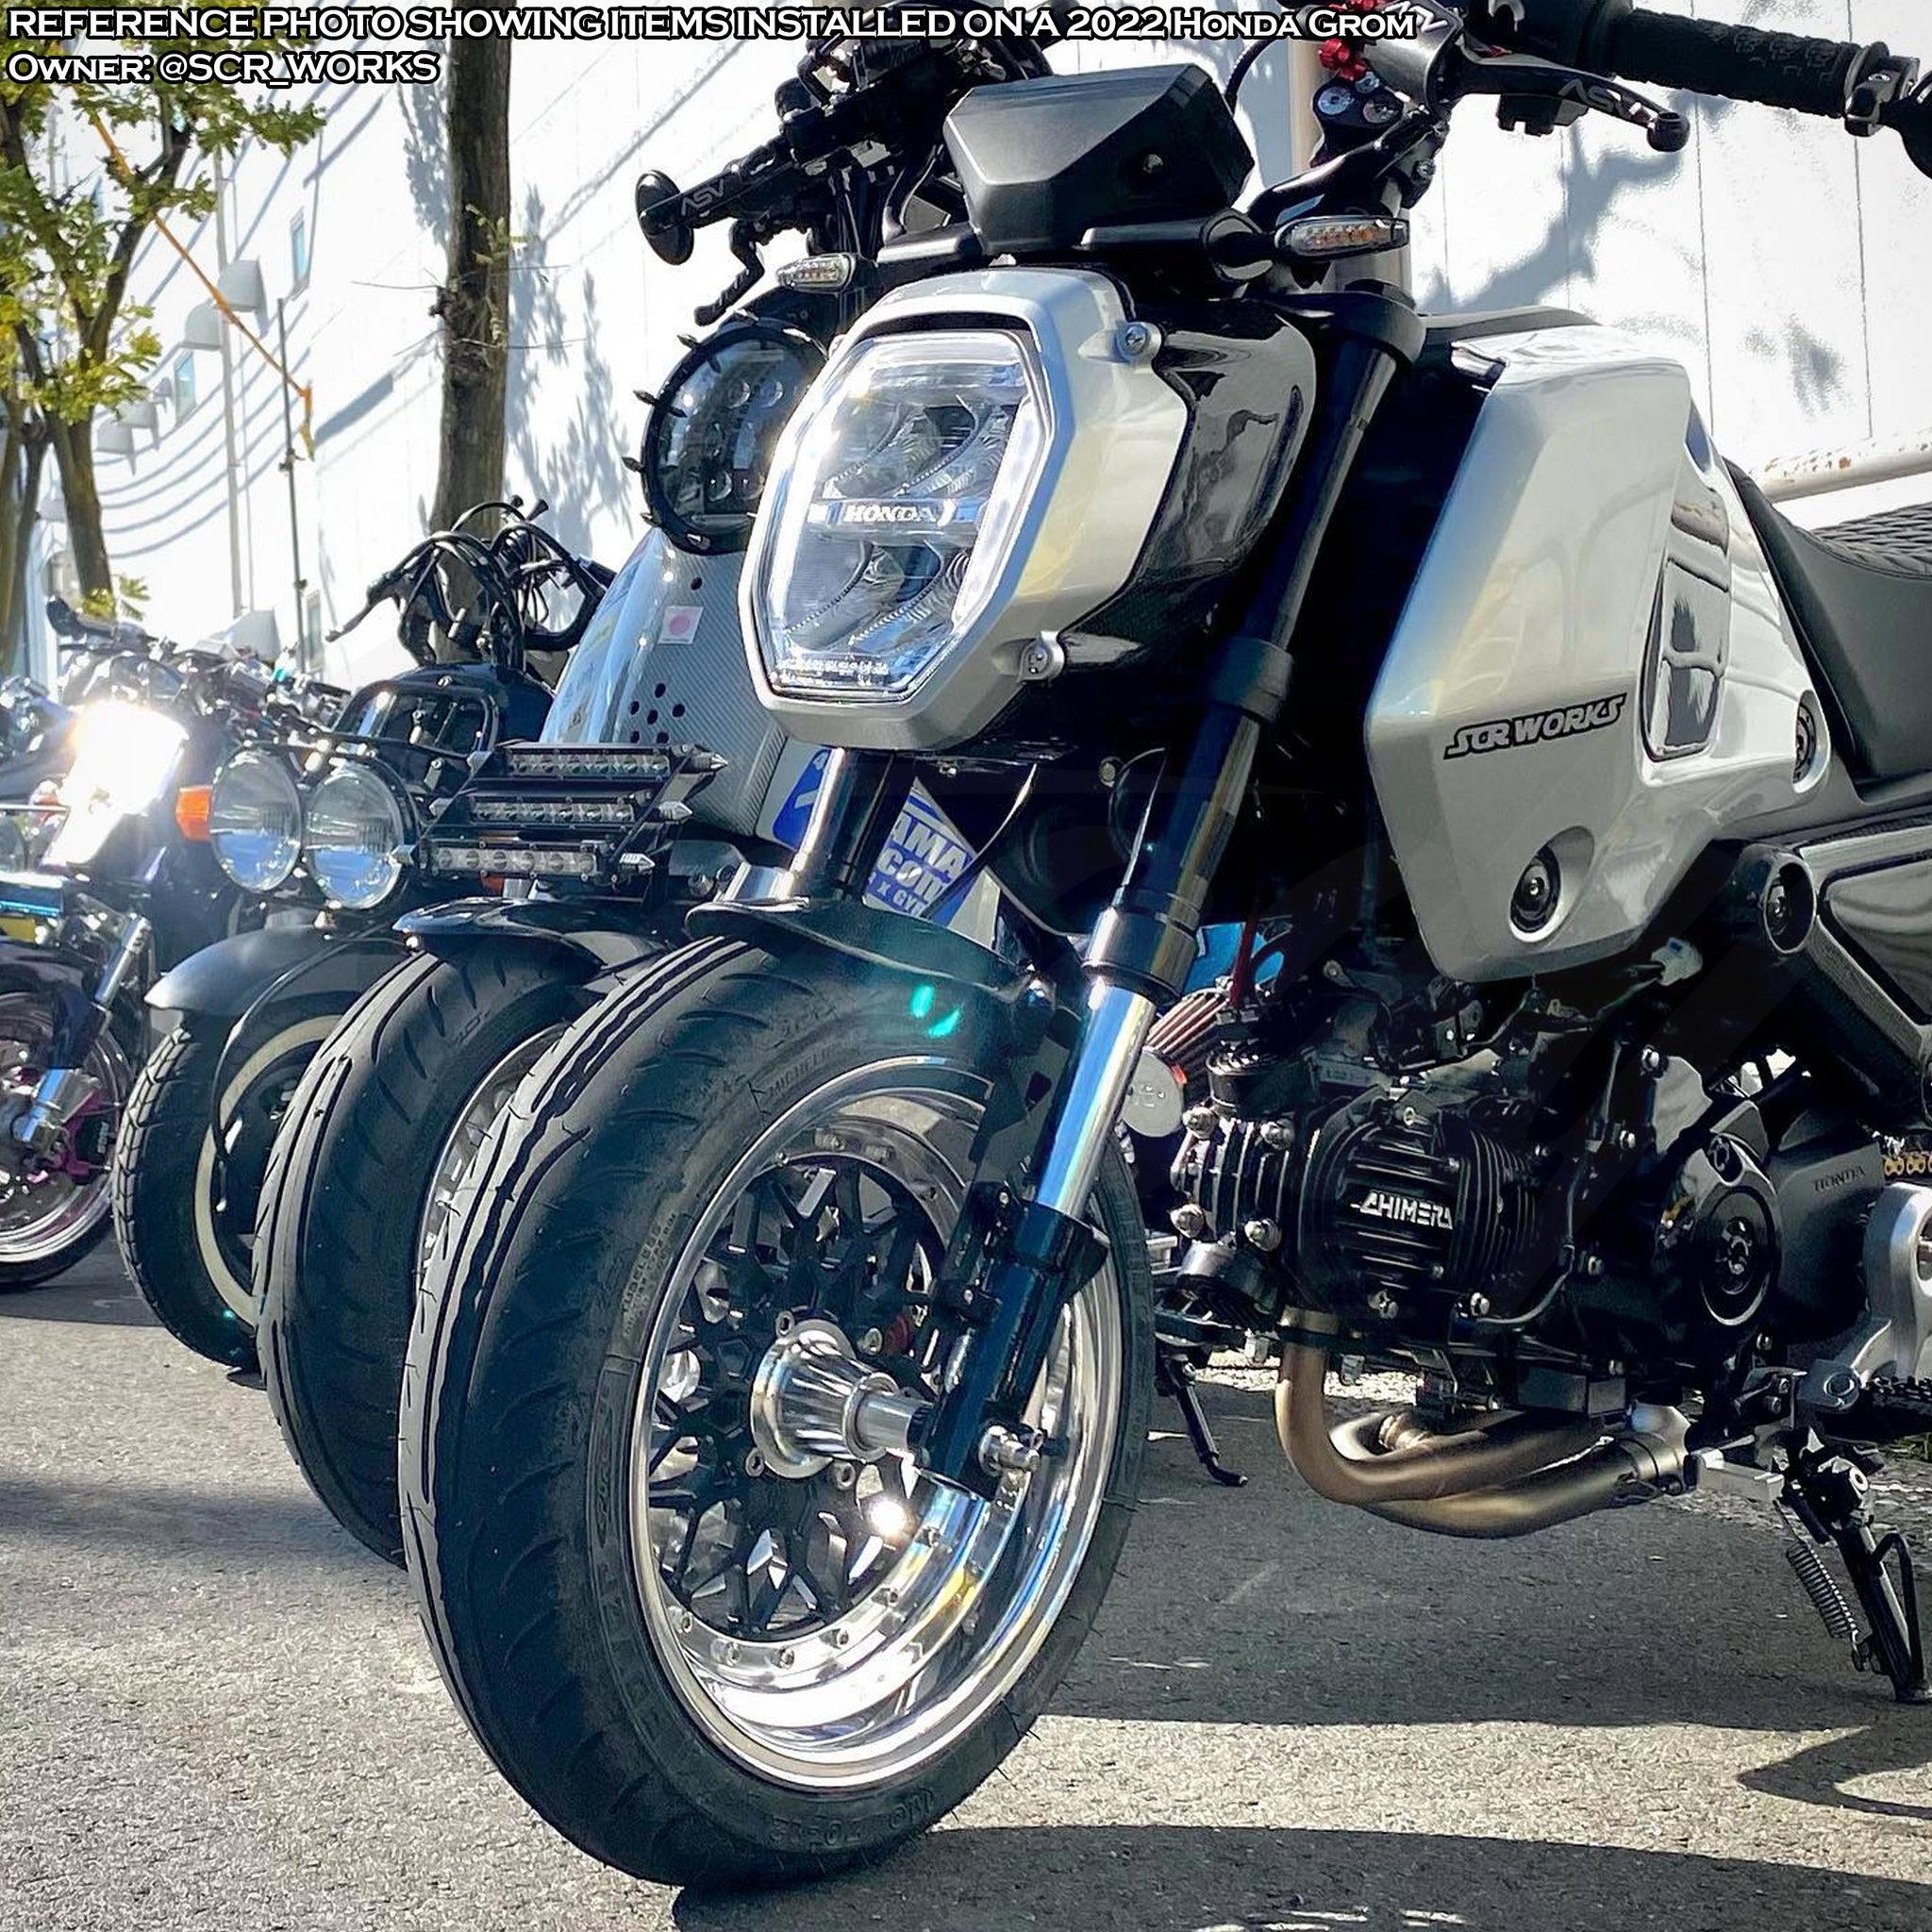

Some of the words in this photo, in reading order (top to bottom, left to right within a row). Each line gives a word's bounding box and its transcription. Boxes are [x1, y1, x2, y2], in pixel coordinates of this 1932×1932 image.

[679, 177, 725, 217] ASV
[841, 504, 938, 524] HONDA
[1443, 718, 1511, 759] SCR
[1511, 692, 1628, 746] WORKS
[1813, 1165, 1867, 1192] HONDA
